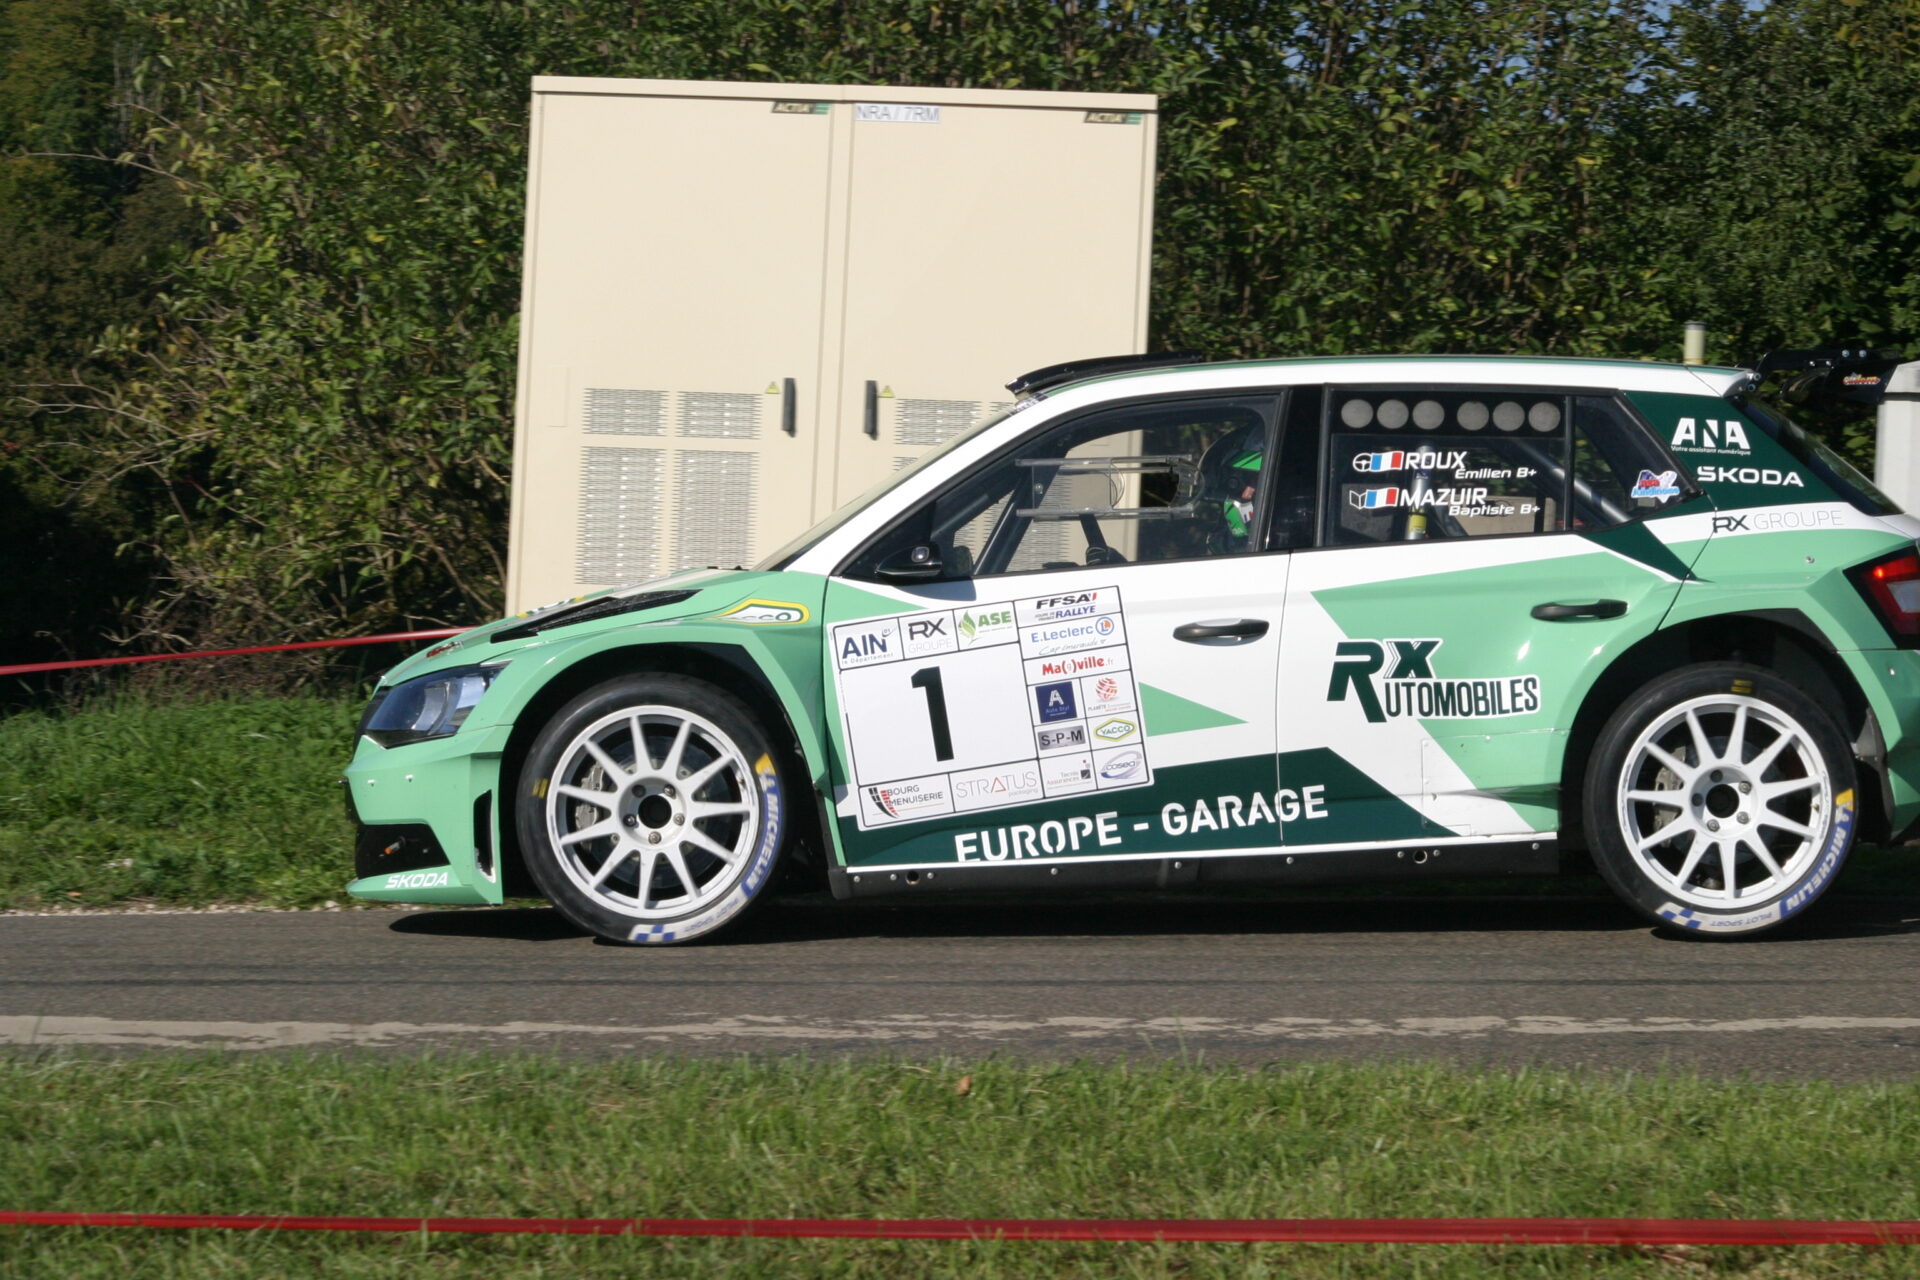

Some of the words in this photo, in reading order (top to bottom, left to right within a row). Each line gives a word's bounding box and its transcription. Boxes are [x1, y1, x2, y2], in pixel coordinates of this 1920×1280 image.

[857, 105, 891, 119] NRA
[904, 106, 939, 121] 7RM
[1671, 417, 1750, 449] ANA
[1405, 451, 1467, 469] ROUX
[1455, 468, 1511, 479] Émilien
[1516, 467, 1537, 478] B+
[1400, 488, 1488, 507] MAZUIR
[1449, 505, 1515, 518] Baptiste
[1520, 504, 1541, 514] B+
[1712, 515, 1750, 533] RX
[1753, 510, 1845, 530] GROUPE
[1036, 593, 1091, 609] FFSA
[978, 611, 1013, 627] ASE
[1055, 605, 1096, 618] RALLYE
[908, 618, 947, 641] RX
[1031, 626, 1093, 643] E.Leclerc
[842, 633, 888, 659] AIN
[908, 639, 952, 654] GROUPE
[911, 666, 954, 762] 1
[1041, 730, 1083, 746] S-P-M
[887, 785, 919, 796] BOURG
[956, 771, 1037, 799] STRATUS
[889, 792, 944, 807] MENUISERIE
[954, 811, 1122, 862] EUROPE
[1161, 785, 1329, 836] GARAGE
[745, 793, 779, 890] MICHELIN
[1786, 827, 1847, 911] MICHELIN
[384, 871, 448, 889] SKODA
